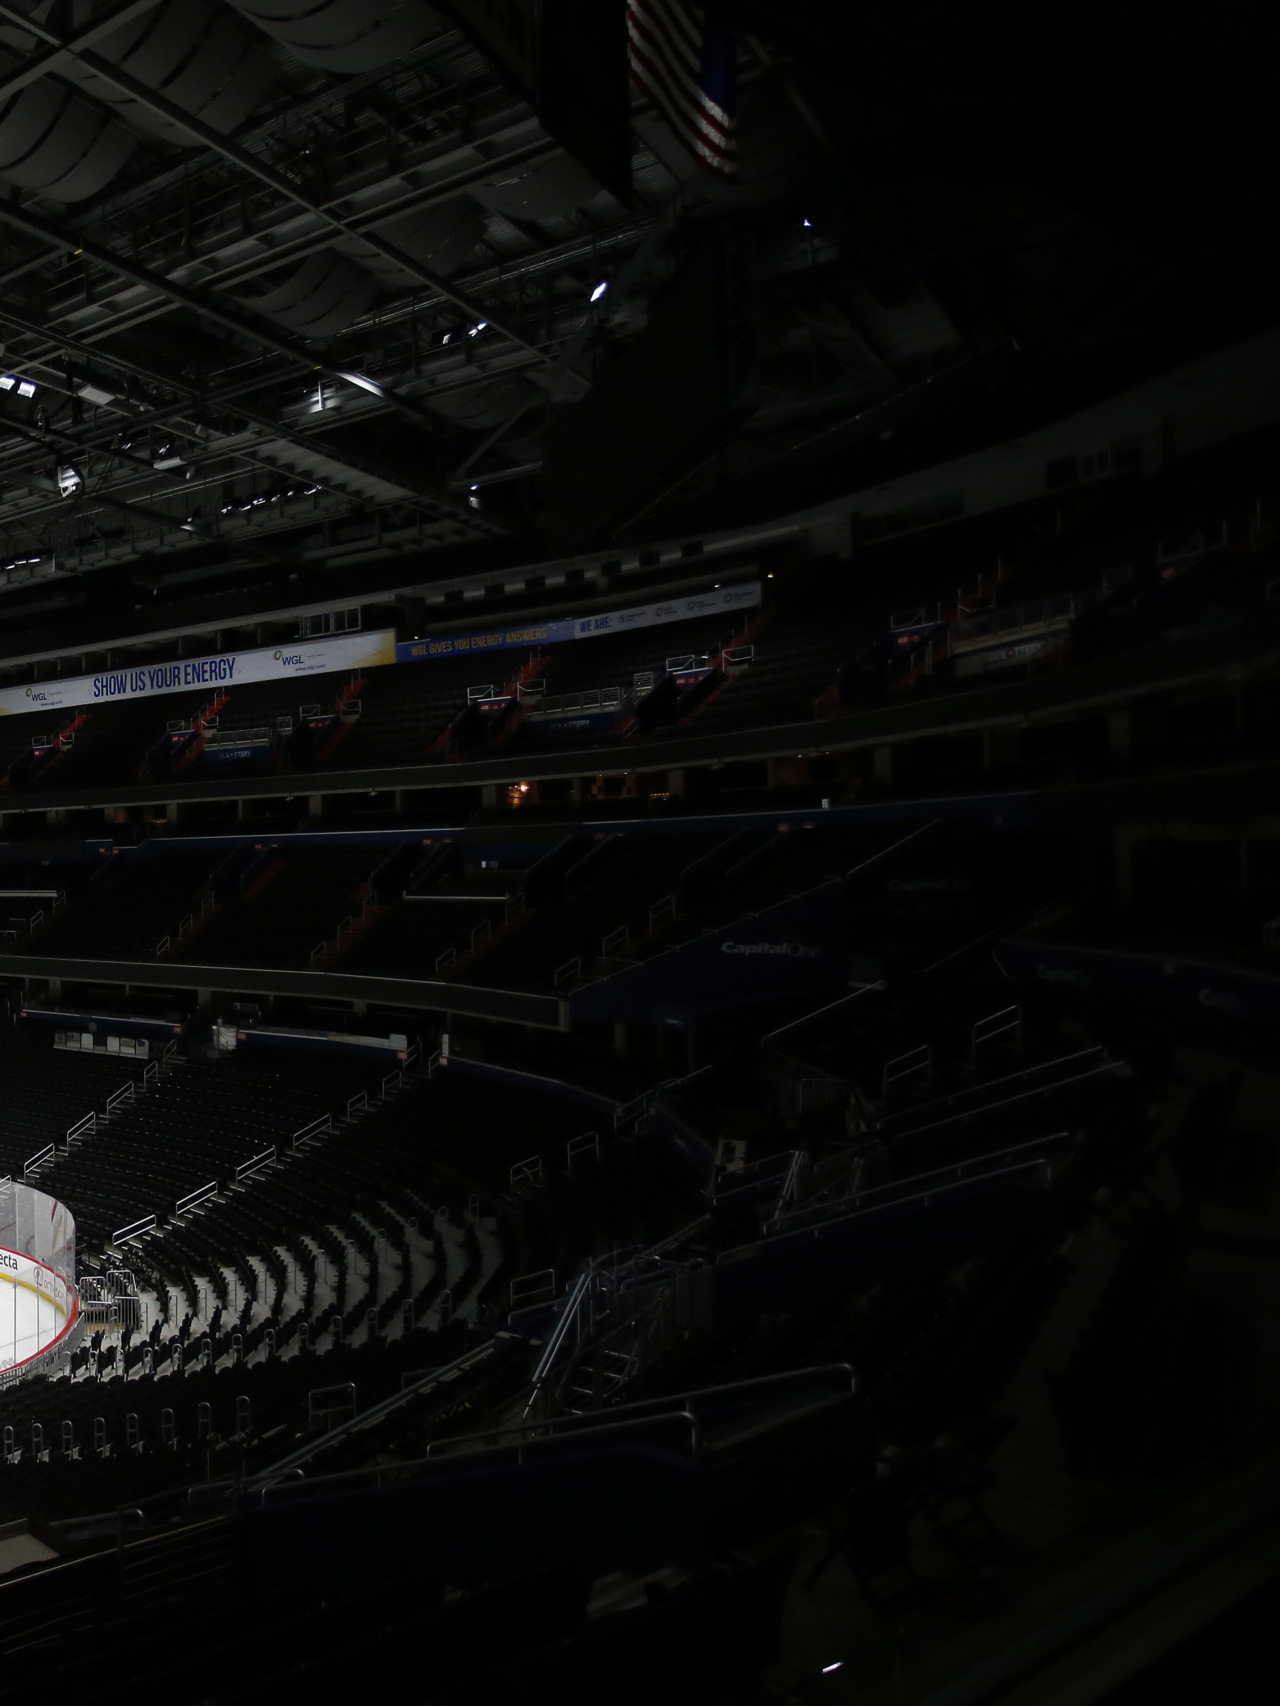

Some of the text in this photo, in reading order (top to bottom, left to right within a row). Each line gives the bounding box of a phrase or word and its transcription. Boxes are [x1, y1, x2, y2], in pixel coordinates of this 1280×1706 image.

[579, 620, 592, 633] WE
[411, 627, 547, 656] WGL GIVES YOU ENERGY ANSWERS
[282, 655, 304, 666] WGL
[93, 657, 236, 698] SHOW US YOUR ENERGY
[32, 692, 47, 702] WGL
